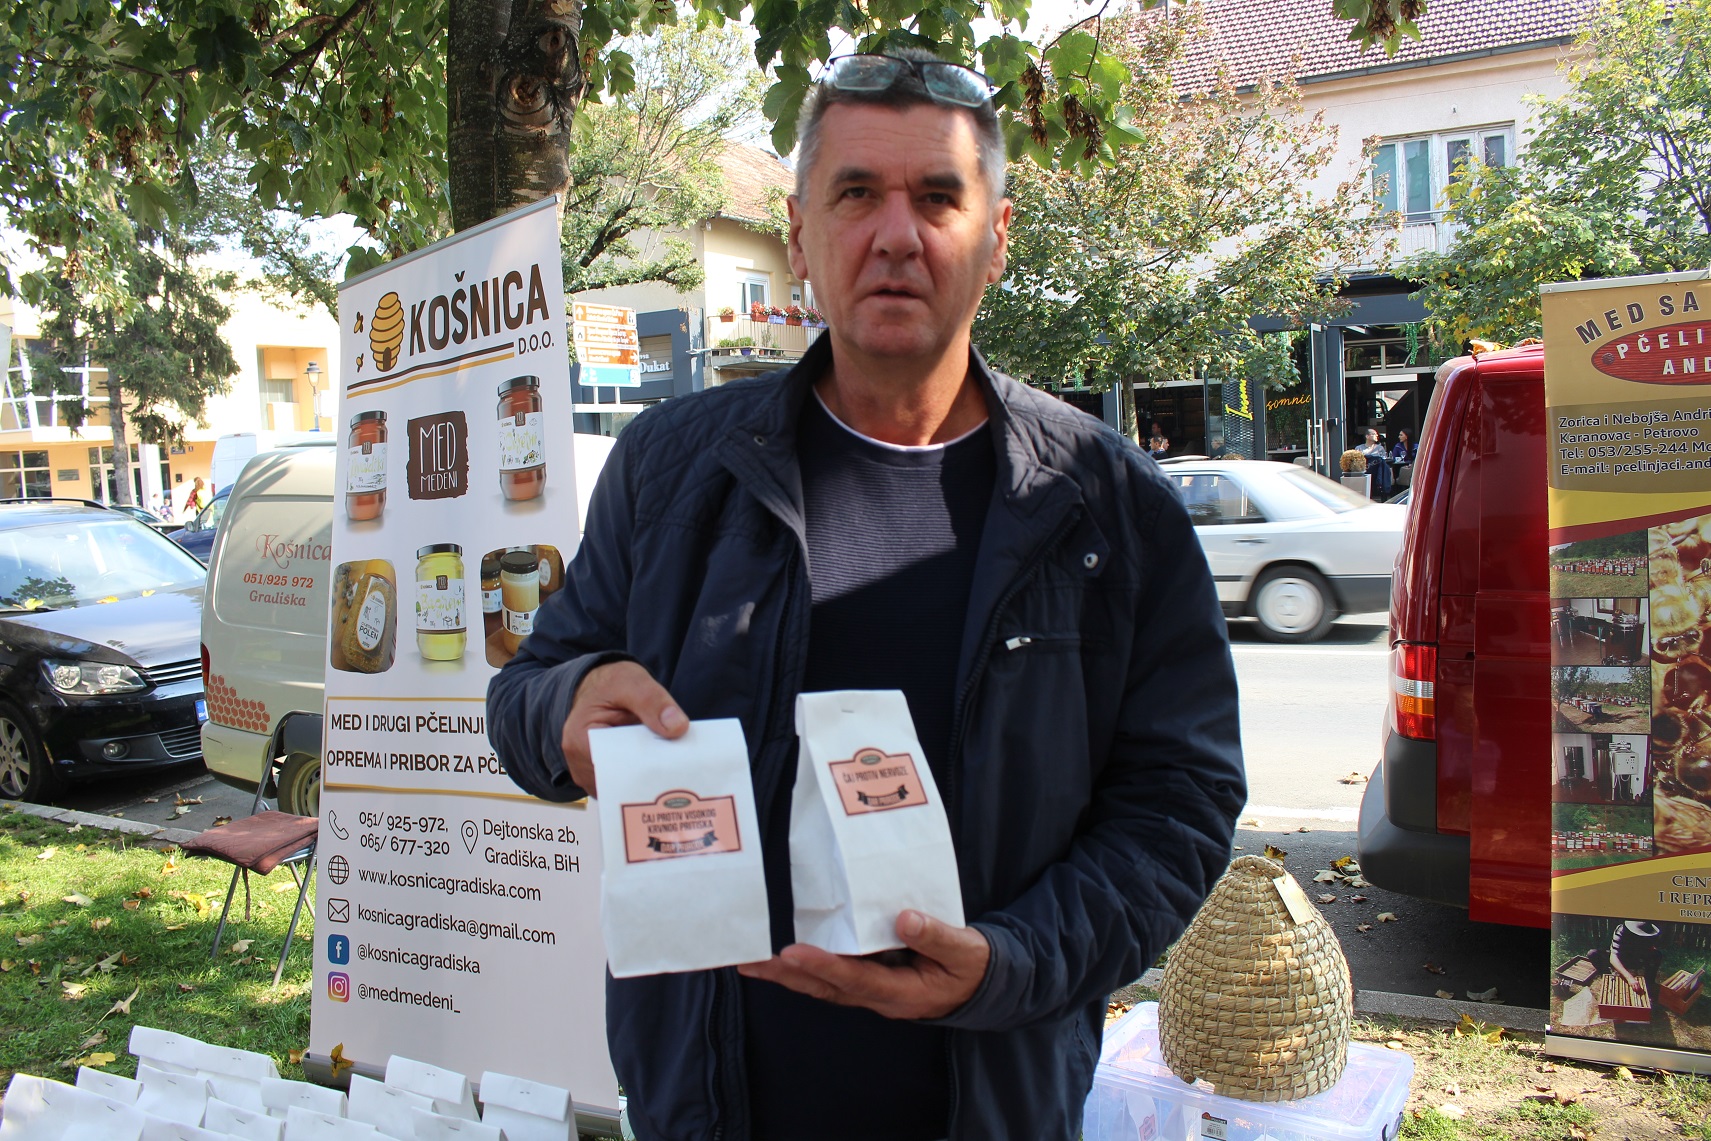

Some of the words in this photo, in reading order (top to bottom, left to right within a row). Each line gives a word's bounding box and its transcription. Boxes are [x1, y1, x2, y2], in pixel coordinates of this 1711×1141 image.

[410, 263, 550, 356] KOŠNICA
[1575, 302, 1645, 344] MED
[1659, 290, 1700, 316] SA
[518, 330, 555, 355] D.O.O.
[1616, 328, 1703, 360] PČELI
[1558, 416, 1600, 428] Zorica
[1604, 415, 1608, 426] i
[1612, 410, 1669, 426] Nebojša
[1560, 431, 1631, 444] Karanovac
[1643, 427, 1699, 440] Petrovo
[420, 421, 456, 474] MED
[1560, 447, 1584, 460] Tel:
[1587, 442, 1688, 458] 053/255-244
[420, 470, 458, 492] MEDENI
[1561, 463, 1610, 476] E-mail:
[256, 534, 332, 570] Košnica
[243, 572, 288, 586] 051/925
[291, 576, 314, 588] 972
[359, 626, 378, 640] POLEN
[331, 713, 362, 730] MED
[365, 714, 369, 731] I
[372, 714, 410, 732] DRUGI
[416, 711, 484, 735] PČELINJI
[327, 750, 382, 770] OPREMA
[384, 752, 387, 770] I
[390, 753, 450, 771] PRIBOR
[454, 755, 474, 773] ZA
[359, 811, 384, 827] 051/
[386, 815, 449, 833] 925-972,
[641, 812, 656, 824] ČAJ
[656, 811, 683, 822] PROTIV
[648, 822, 678, 834] KRVNOG
[483, 818, 554, 842] Dejtonska
[558, 826, 580, 846] 2b,
[360, 834, 387, 852] 065/
[390, 836, 450, 856] 677-320
[484, 847, 550, 871] Gradiška,
[554, 853, 580, 873] BiH
[358, 867, 542, 901] www.kosnicagradiska.com
[1671, 875, 1711, 888] CEN
[1658, 891, 1666, 903] I
[358, 904, 556, 945] kosnicagradiska@gmail.com
[357, 942, 481, 974] @kosnicagradiska
[357, 983, 461, 1014] @medmedeni_
